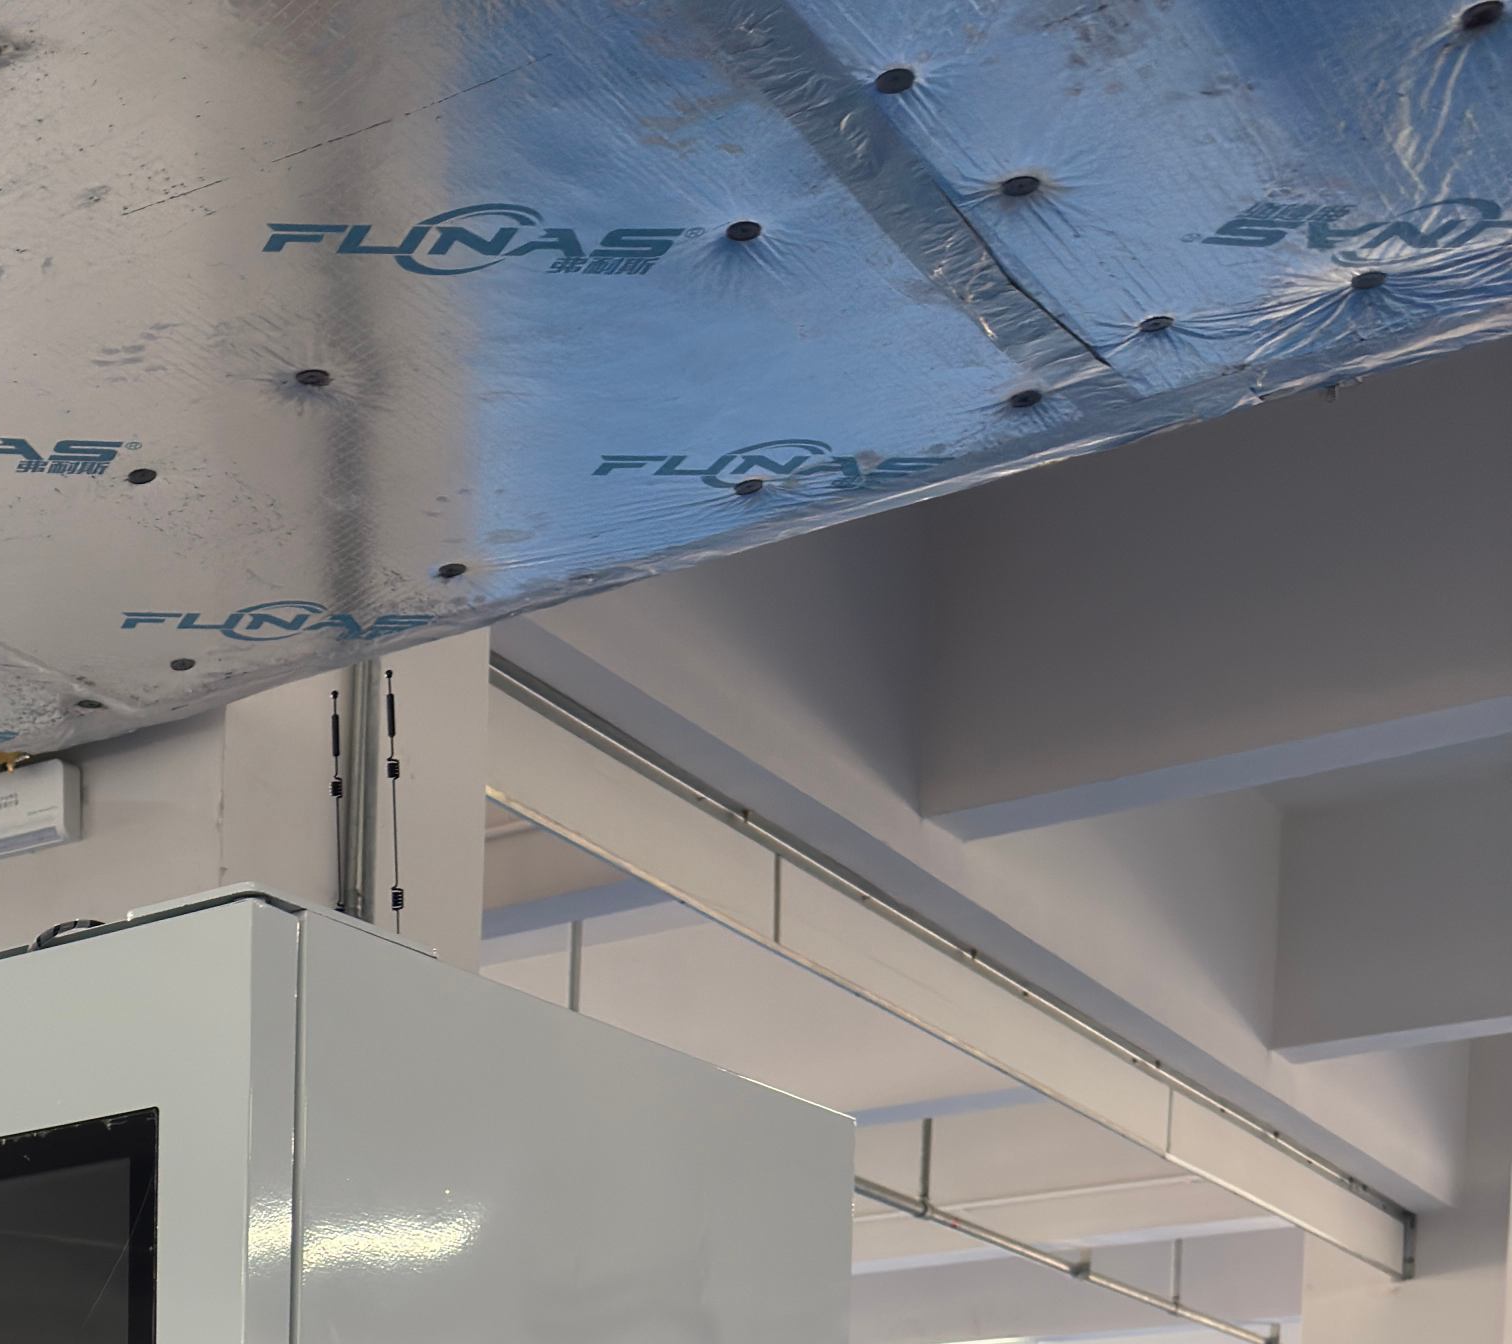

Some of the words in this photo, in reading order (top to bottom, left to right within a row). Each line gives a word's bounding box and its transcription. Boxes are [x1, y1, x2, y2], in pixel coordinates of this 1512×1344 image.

[262, 209, 685, 269] FUNAS
[548, 256, 658, 275] 弗耐斯
[16, 460, 110, 475] 弗耐斯
[593, 446, 955, 486] FUNAS
[121, 605, 434, 641] FUNAS
